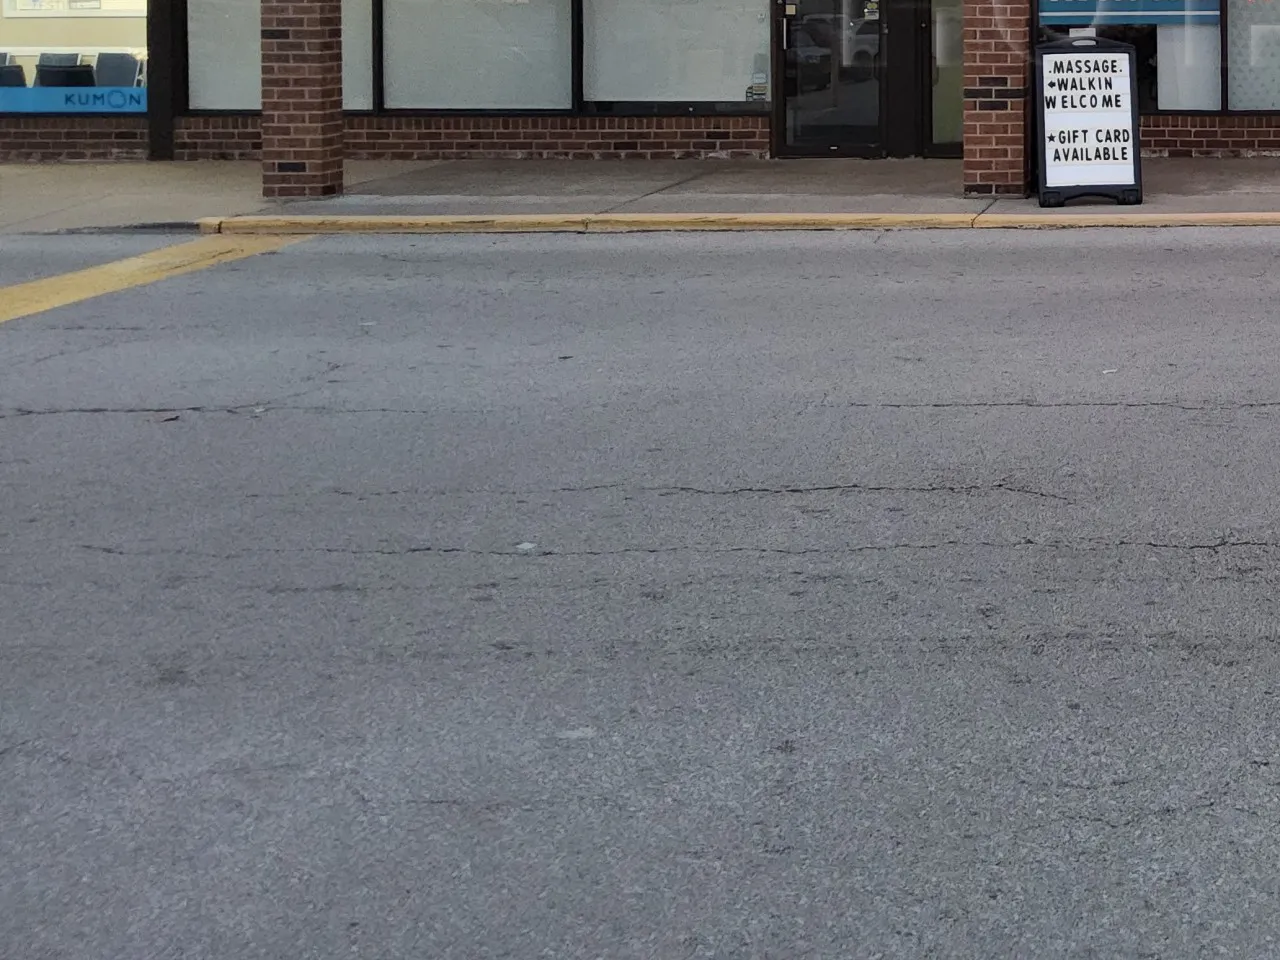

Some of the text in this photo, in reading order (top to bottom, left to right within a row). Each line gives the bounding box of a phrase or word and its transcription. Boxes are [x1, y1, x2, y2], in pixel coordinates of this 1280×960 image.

[1057, 77, 1113, 91] WALKIN
[64, 90, 141, 109] KUMON
[1045, 94, 1122, 109] WELCOME
[1058, 128, 1130, 144] GIFT CARD
[1053, 147, 1129, 162] AVAILABLE
